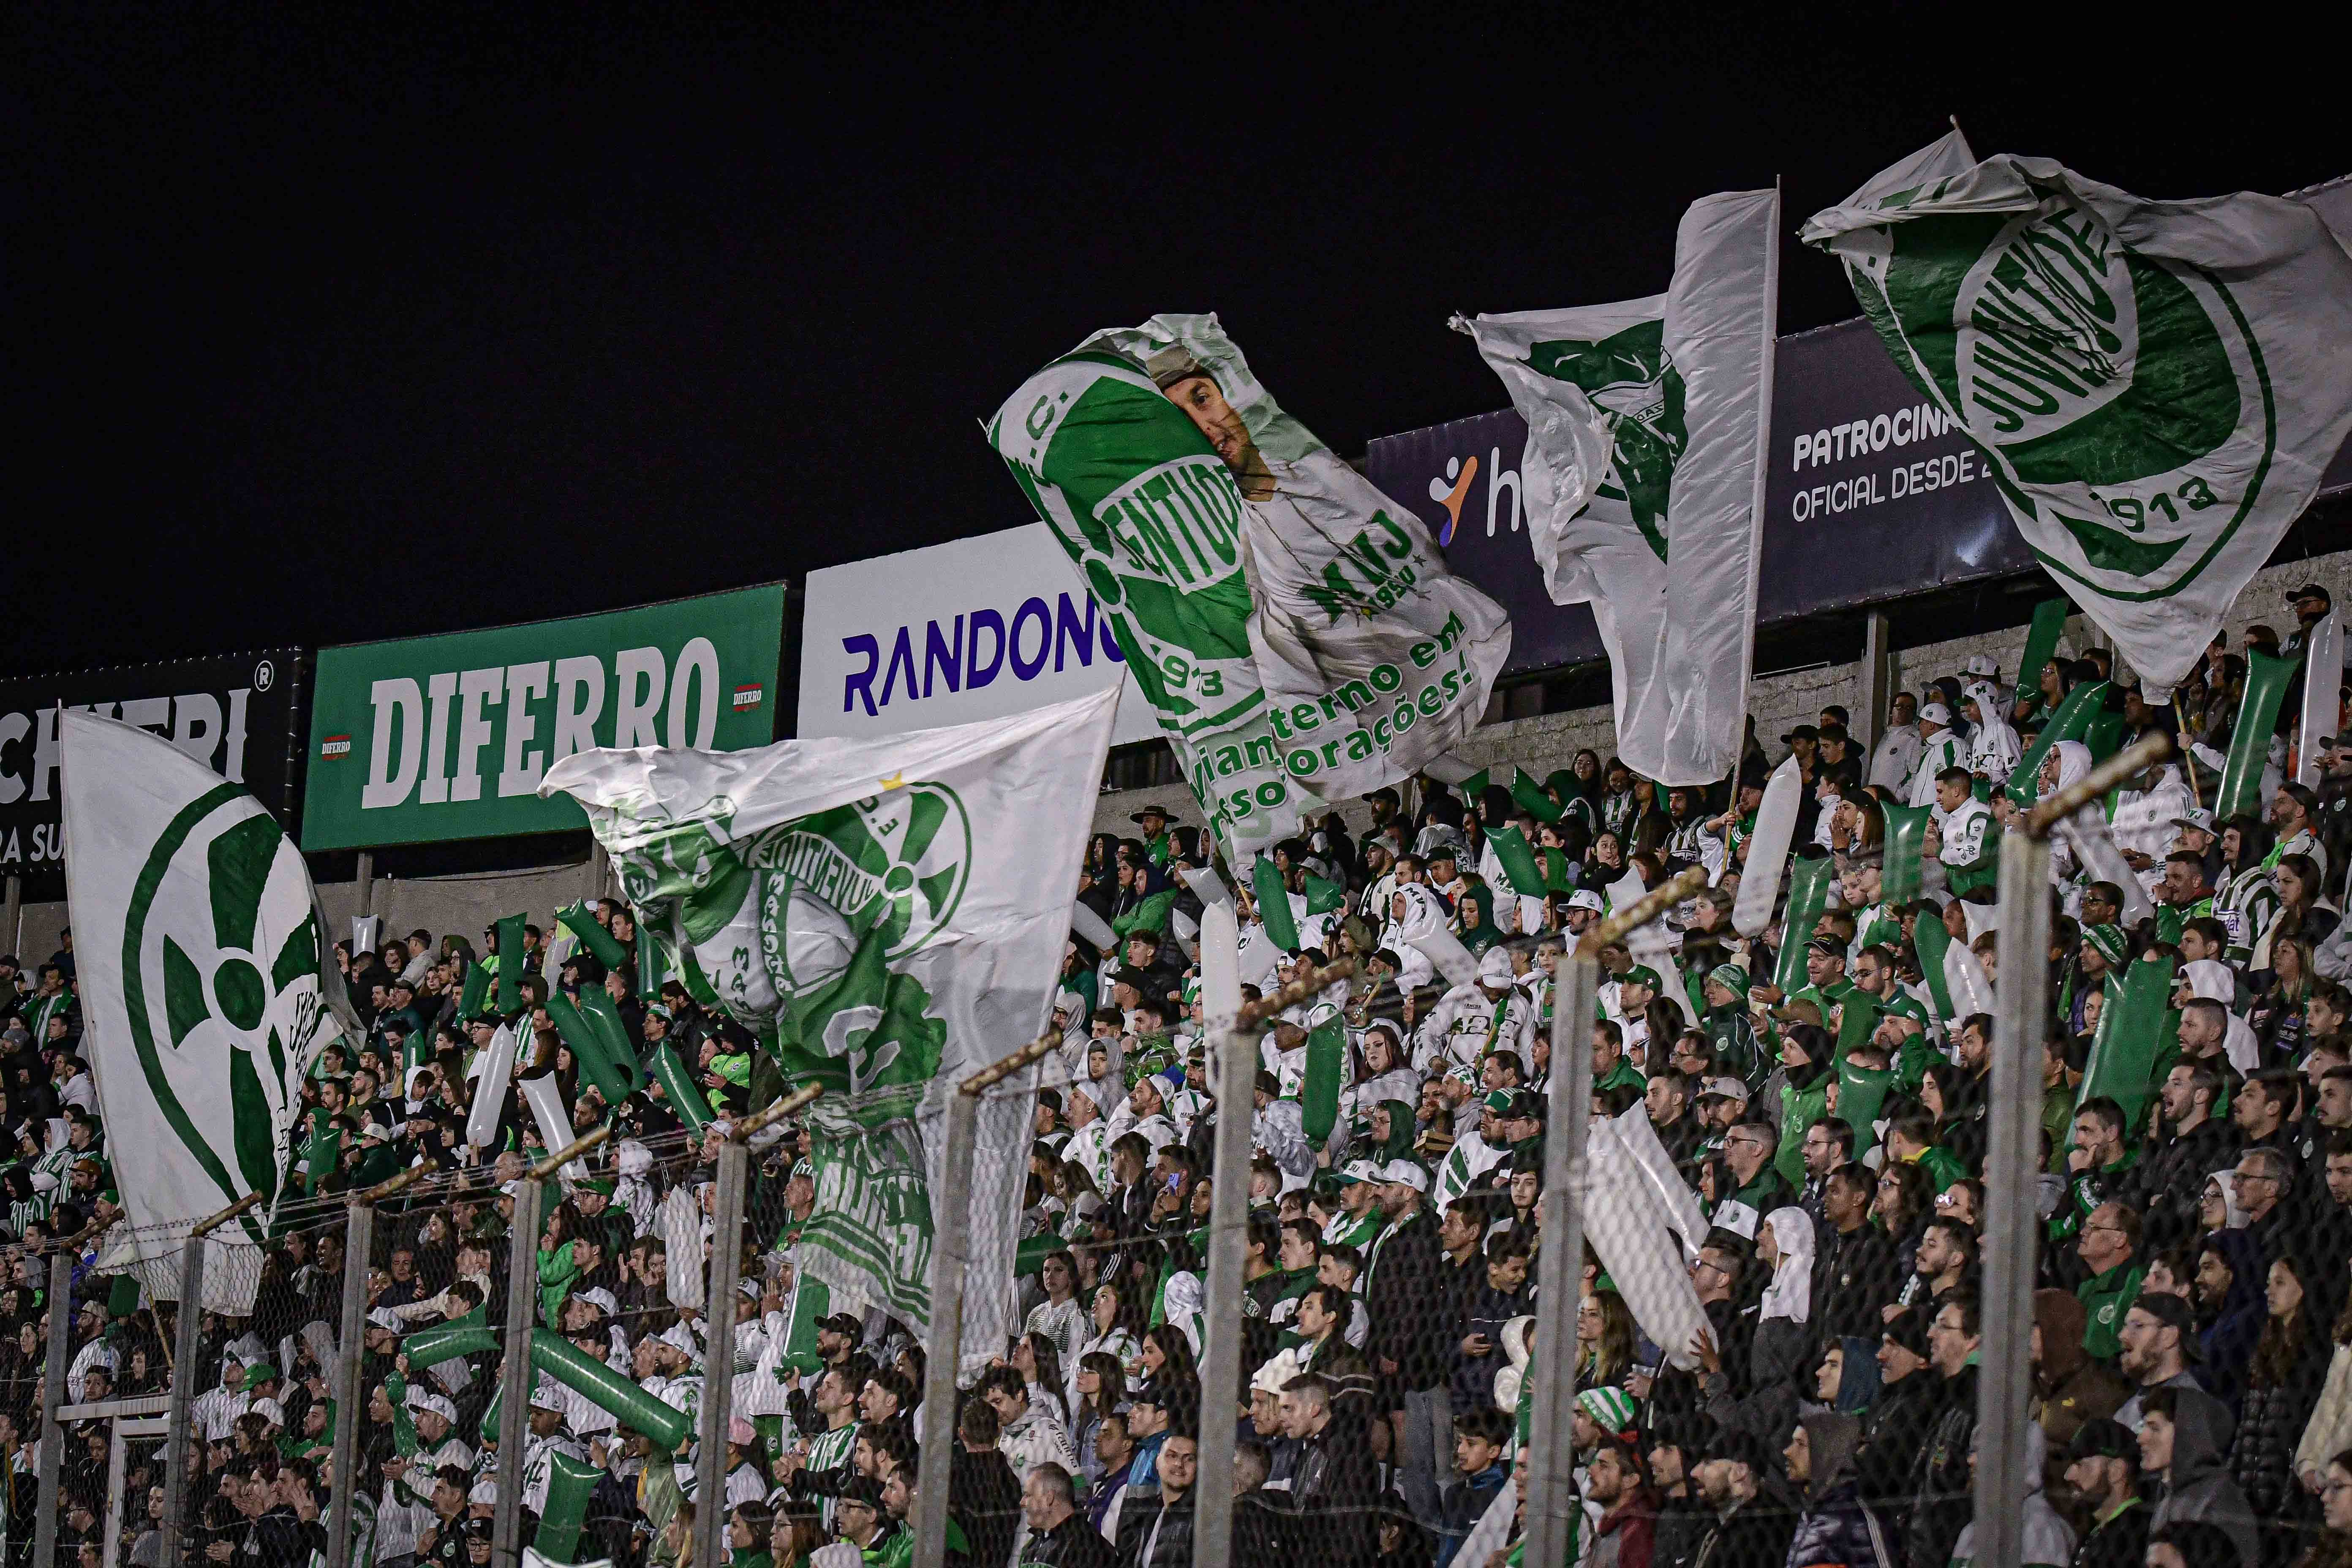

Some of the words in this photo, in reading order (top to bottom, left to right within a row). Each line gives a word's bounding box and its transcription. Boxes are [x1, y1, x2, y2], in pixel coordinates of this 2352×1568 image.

[1971, 209, 2122, 432] JUVENTUDE
[1793, 474, 1885, 522] OFICIAL
[1892, 449, 1975, 499] DESDE
[2088, 476, 2218, 533] 1913
[733, 689, 762, 706] DIFERRO
[1149, 644, 1224, 697] 913
[362, 637, 719, 809] DIFERRO
[1286, 649, 1473, 777] orações!
[0, 689, 251, 803] CHRI
[321, 741, 350, 754] DIFERRO
[0, 827, 21, 863] A
[30, 824, 65, 862] SU
